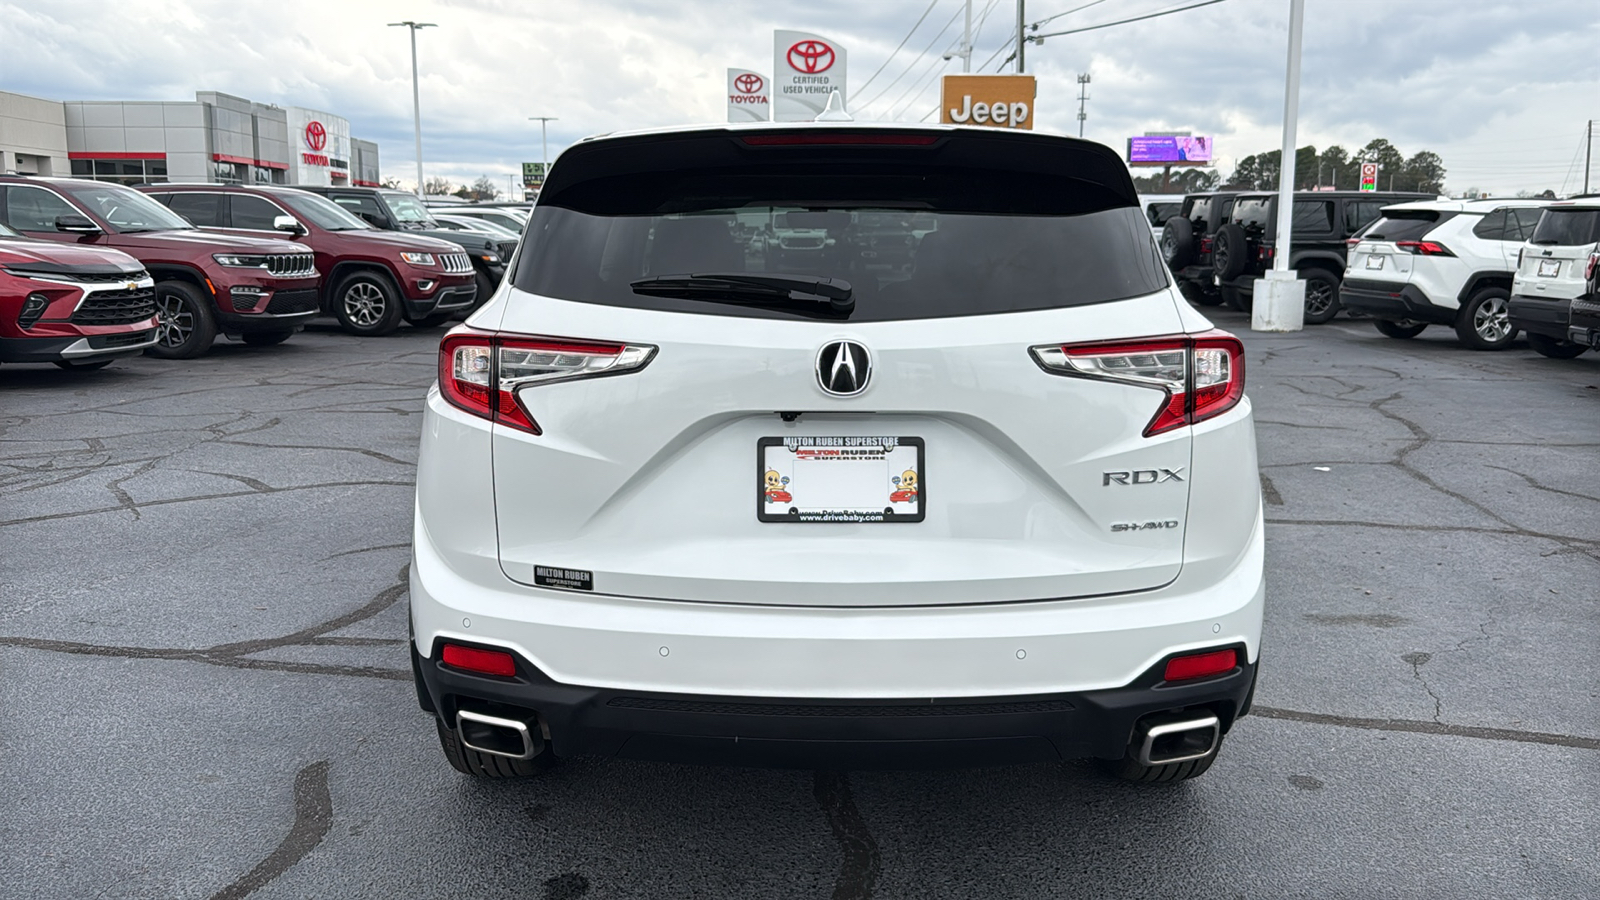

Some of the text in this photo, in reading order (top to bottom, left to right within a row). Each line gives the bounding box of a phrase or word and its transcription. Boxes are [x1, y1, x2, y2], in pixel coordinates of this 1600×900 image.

[792, 76, 829, 84] CERTIFIED
[783, 86, 803, 94] USED
[729, 95, 768, 104] TOYOTA
[949, 94, 1028, 127] Jeep
[303, 153, 329, 166] TOYOTA
[783, 437, 899, 446] MILTON RUBEN SUPERSTORE
[1102, 467, 1185, 487] RDX
[1110, 520, 1179, 532] SH-AWD
[536, 567, 590, 581] MILTON RUBEN
[546, 578, 582, 586] SUPERSTORE
